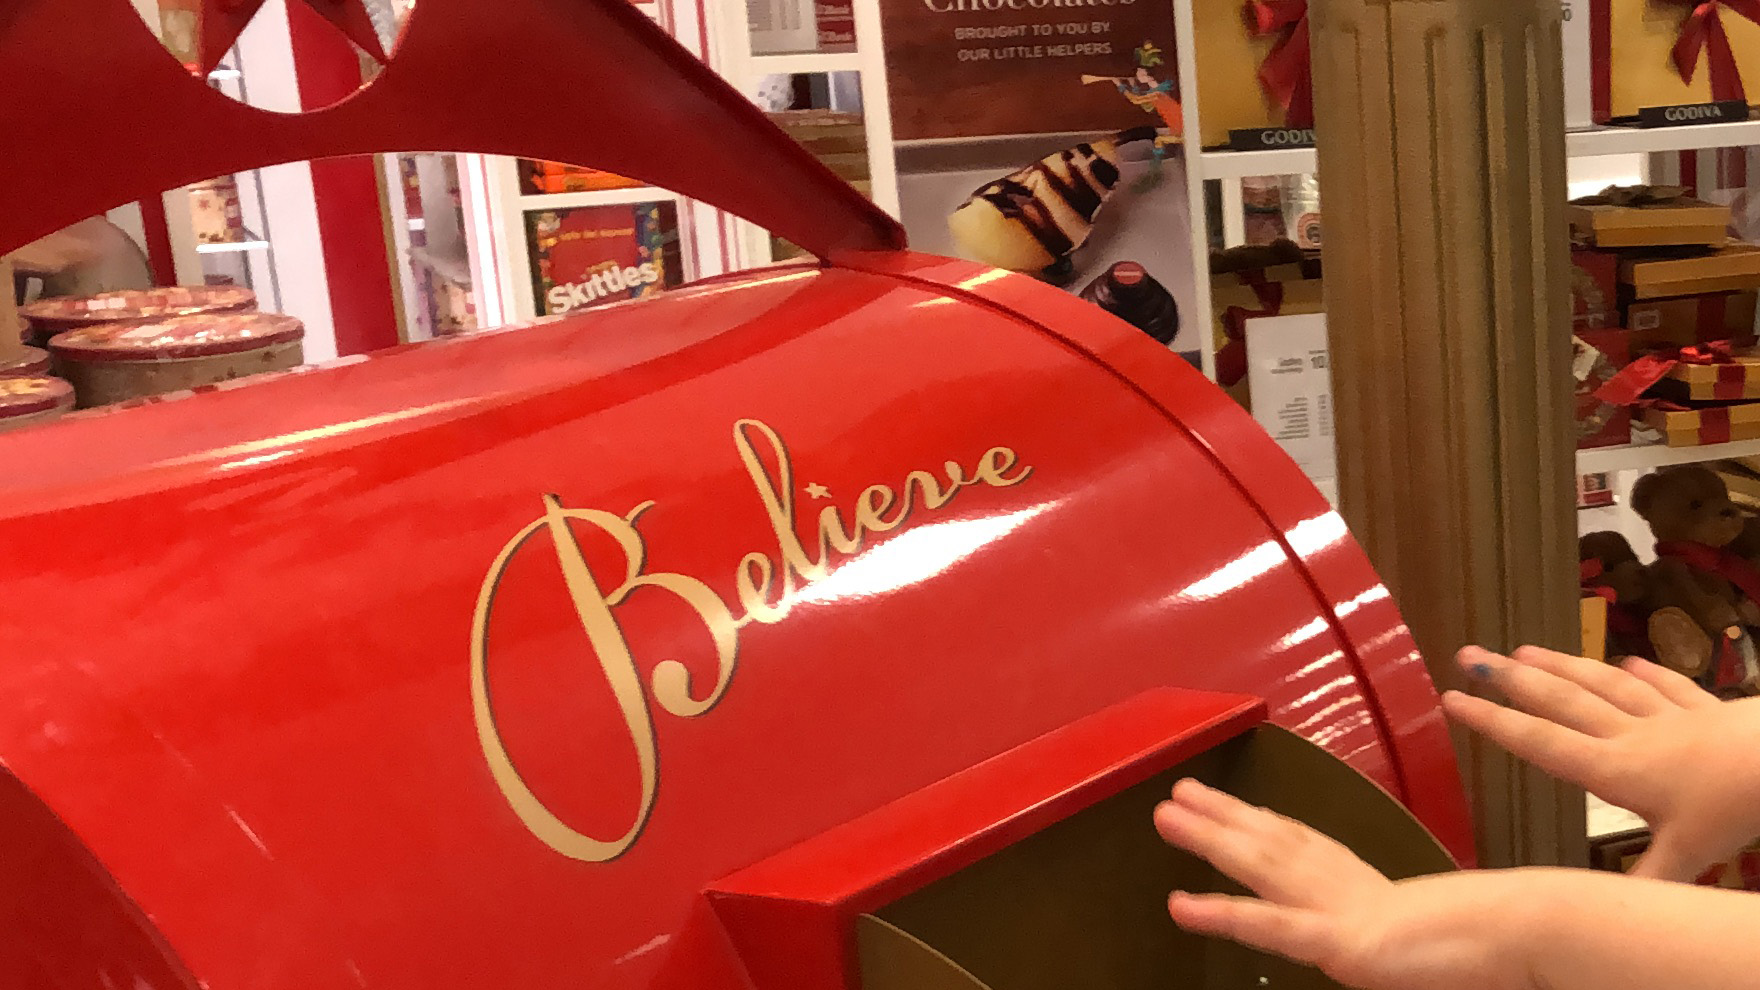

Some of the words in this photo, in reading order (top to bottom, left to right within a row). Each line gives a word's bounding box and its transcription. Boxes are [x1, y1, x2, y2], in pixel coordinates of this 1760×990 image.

[954, 25, 1026, 40] BROUGHT
[1032, 24, 1052, 36] TO
[1057, 22, 1088, 35] YOU
[1092, 21, 1111, 33] BY
[957, 48, 990, 62] OUR
[995, 46, 1043, 60] LITTLE
[1047, 42, 1113, 57] HELPERS
[1664, 105, 1722, 121] GODIVA
[548, 262, 659, 314] Skittles
[469, 418, 1033, 863] Believe
